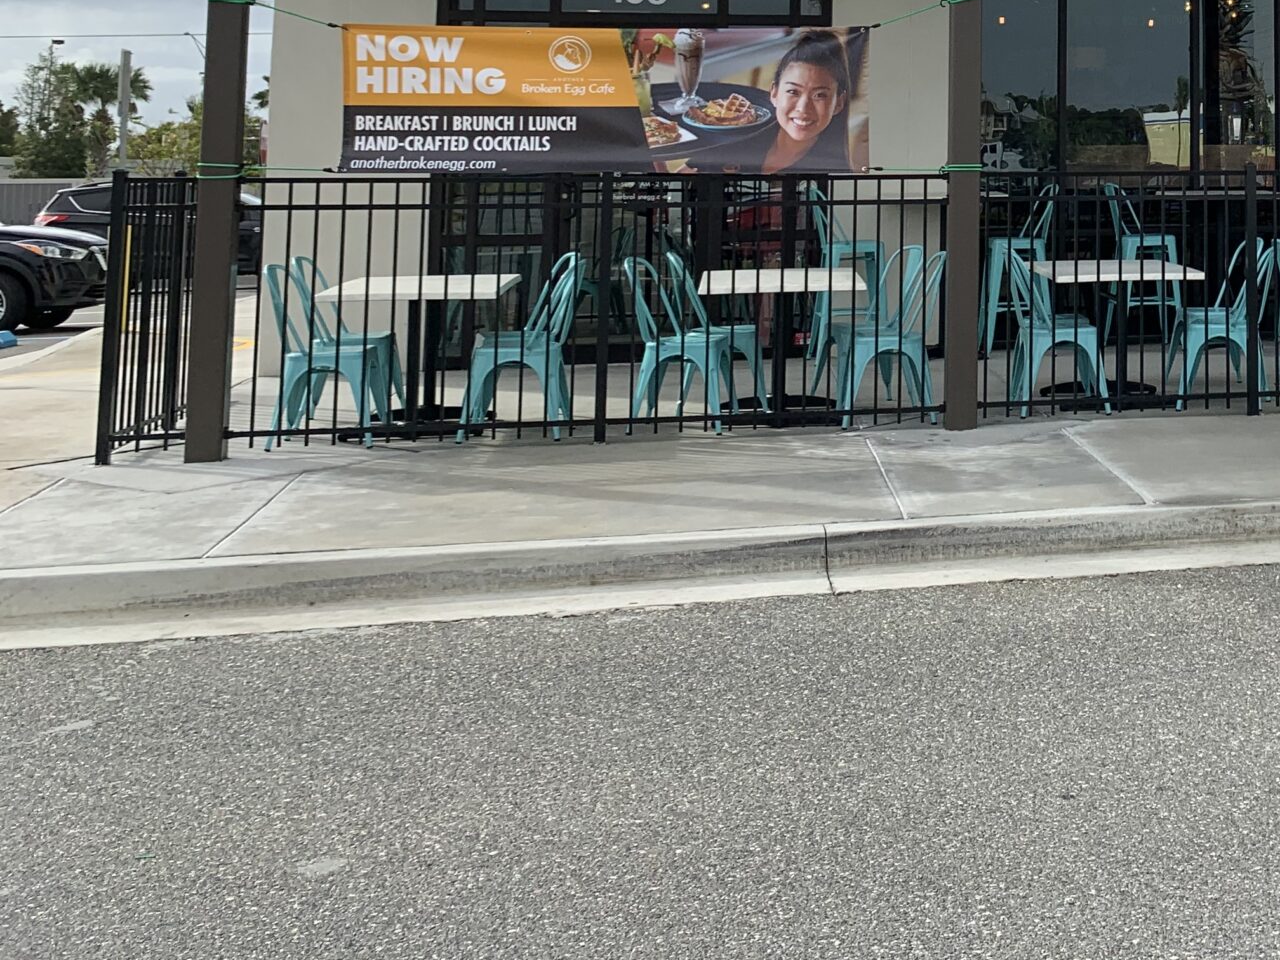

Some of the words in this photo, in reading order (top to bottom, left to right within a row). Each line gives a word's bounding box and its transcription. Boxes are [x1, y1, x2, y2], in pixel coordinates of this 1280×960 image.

[356, 34, 464, 62] NOW
[356, 66, 507, 95] HIRING
[521, 83, 561, 94] Broken
[564, 83, 586, 96] Egg
[588, 83, 615, 95] Cafe
[355, 115, 438, 131] BREAKFAST
[452, 115, 514, 131] BRUNCH
[528, 116, 577, 131] LUNCH
[354, 136, 468, 152] HAND-CRAFTED
[473, 136, 551, 152] COCKTAILS
[350, 156, 496, 171] anotherbrokenegg.com
